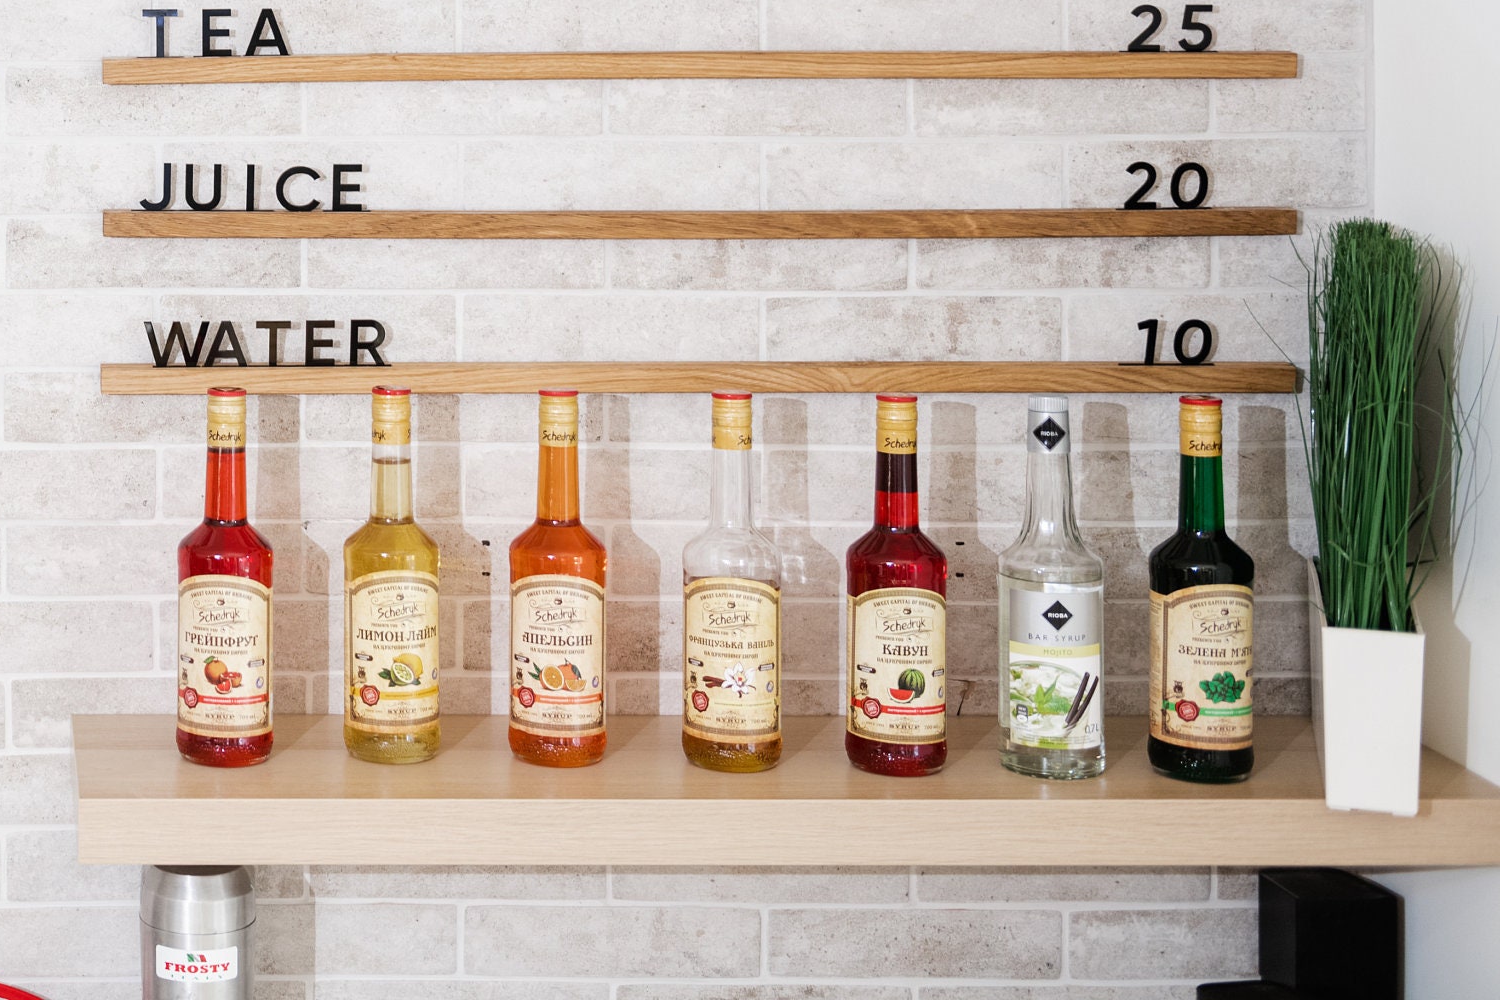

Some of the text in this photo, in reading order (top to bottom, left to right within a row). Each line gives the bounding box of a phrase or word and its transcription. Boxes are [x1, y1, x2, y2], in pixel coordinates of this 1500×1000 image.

[142, 4, 1213, 57] TEA 25
[139, 161, 1209, 211] JUICE 20
[143, 319, 1213, 366] WATER 10
[208, 429, 242, 445] Schedryk
[884, 437, 917, 451] Schedry
[1189, 440, 1222, 454] Schedry
[199, 608, 240, 623] Schedryk
[377, 602, 419, 619] Schedryk
[535, 607, 577, 623] Schedryk
[708, 611, 752, 626] Schedryk
[882, 617, 926, 633] Schedryk
[1200, 617, 1242, 633] Schedryk
[185, 631, 258, 647] ГРЕЙПФРУТ
[356, 625, 437, 642] ЛИМОН ЛАЙМ
[522, 631, 593, 647] АПЕЛЬСИН
[1028, 633, 1087, 642] BAR SYRUP
[882, 644, 928, 657] КАВУН
[1043, 649, 1073, 657] MOJITO
[1178, 644, 1226, 658] ЗЕЛЕНА
[164, 961, 230, 973] FROSTY
